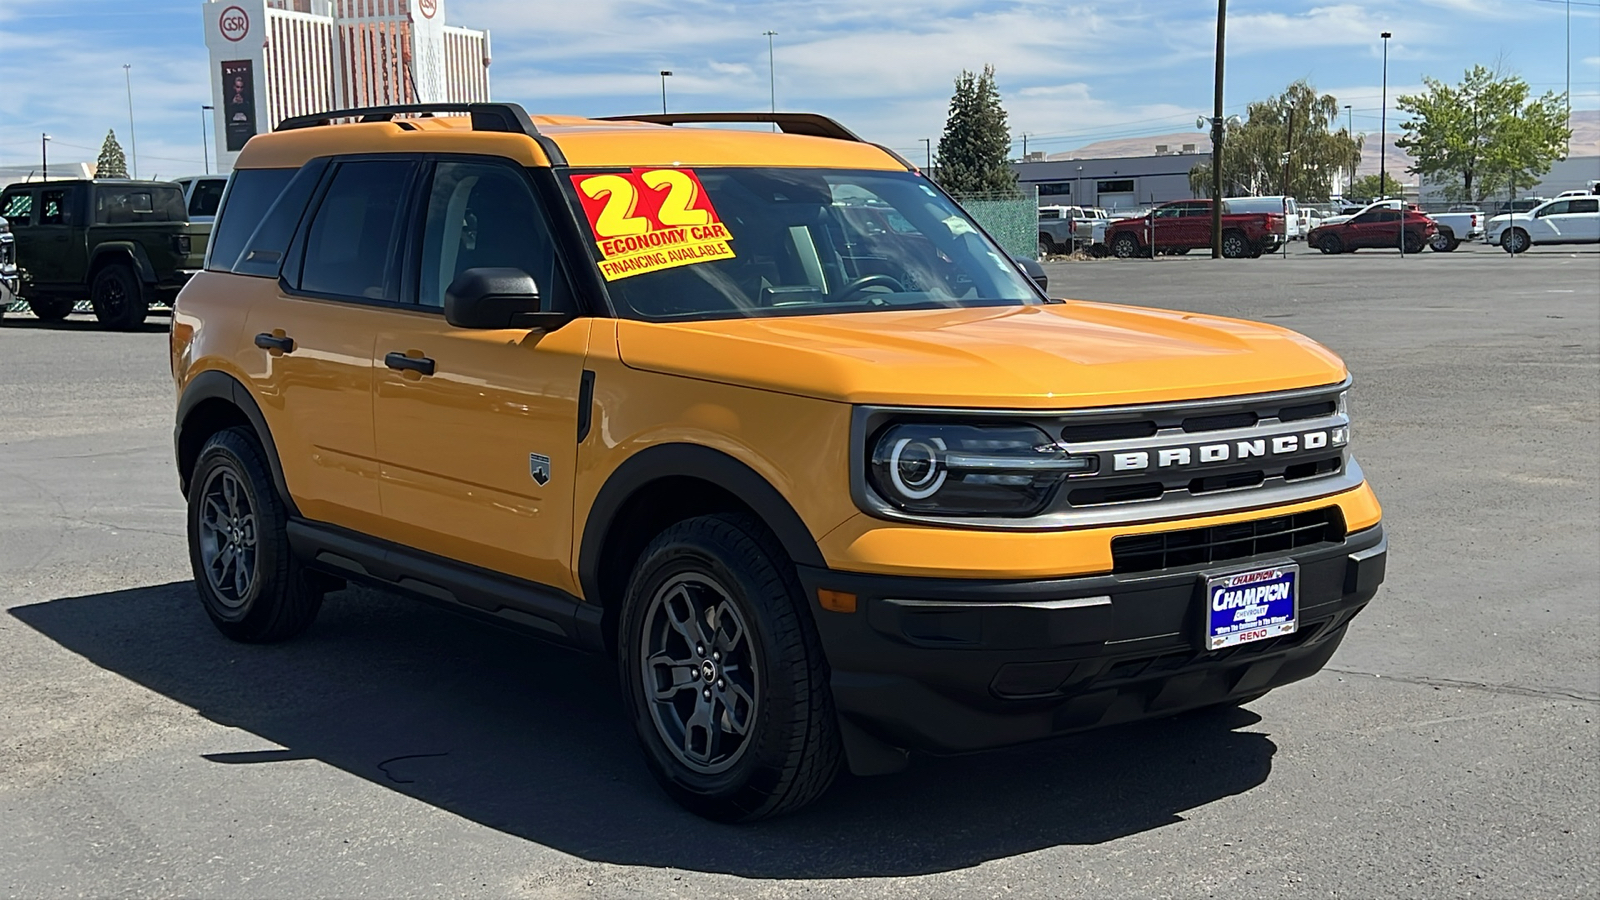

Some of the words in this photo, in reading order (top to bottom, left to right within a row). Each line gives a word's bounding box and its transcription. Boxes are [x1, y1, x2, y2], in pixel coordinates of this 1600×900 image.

[223, 16, 245, 31] GSR
[580, 169, 713, 237] 22
[602, 229, 687, 256] ECONOMY
[691, 225, 726, 240] CAR
[602, 252, 668, 276] FINANCING
[669, 243, 729, 263] AVAILABLE
[1113, 431, 1327, 471] BRONCO
[1232, 570, 1274, 585] CHAMPION
[1213, 582, 1290, 611] CHAMPION
[1236, 607, 1266, 619] CHEVROLET
[1239, 629, 1267, 642] RENO
